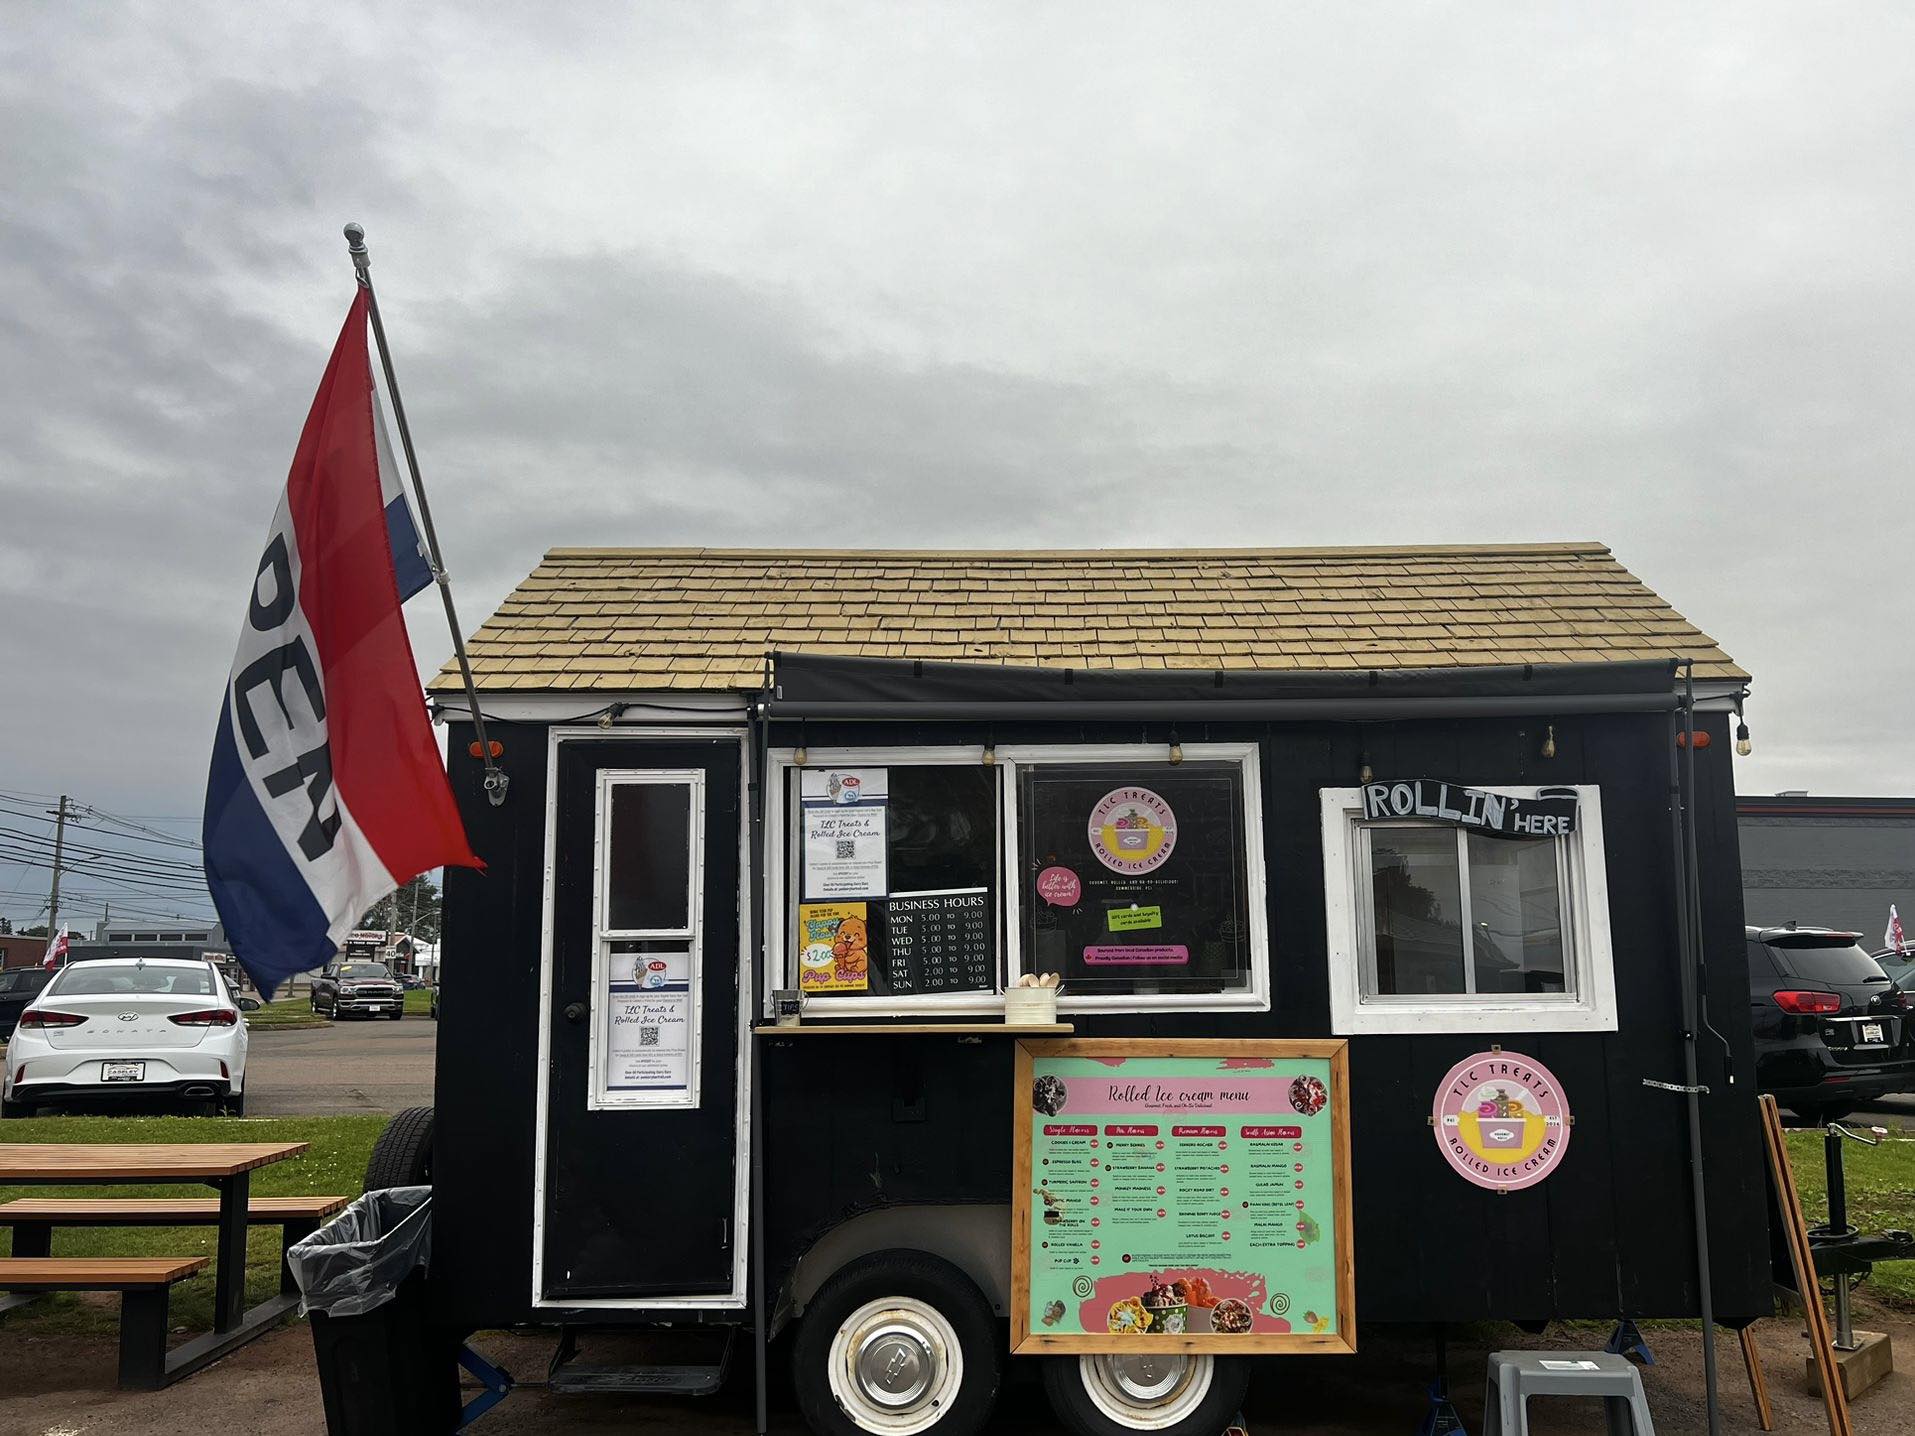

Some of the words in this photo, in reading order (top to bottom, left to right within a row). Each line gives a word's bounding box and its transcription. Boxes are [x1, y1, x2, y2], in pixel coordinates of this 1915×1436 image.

[1098, 797, 1116, 815] TLC
[1123, 791, 1166, 815] TREATS
[1366, 780, 1519, 830] ROLLIN'
[1514, 813, 1571, 835] HERE
[838, 820, 862, 828] Treats
[810, 830, 835, 840] Rolled
[836, 830, 851, 838] Ice
[853, 829, 880, 838] Cream
[1095, 842, 1123, 867] ROLLED
[1128, 862, 1143, 870] ICE
[1148, 842, 1171, 865] CREAM
[889, 899, 940, 911] BUSINESS
[944, 896, 984, 908] HOURS
[890, 915, 913, 924] MON
[891, 926, 908, 935] TUE
[891, 937, 913, 945] WED
[892, 947, 912, 956] THU
[892, 958, 906, 967] FRI
[802, 969, 831, 984] Pup
[835, 968, 866, 983] Cups
[892, 969, 908, 978] SAT
[893, 980, 912, 989] SUN
[643, 1005, 667, 1014] Treats
[614, 1016, 639, 1025] Rolled
[641, 1016, 655, 1025] Ice
[657, 1015, 685, 1024] Cream
[1453, 1071, 1478, 1097] TLC
[1489, 1064, 1549, 1098] TREATS
[1108, 1085, 1151, 1102] Rolled
[1155, 1085, 1174, 1102] Ice
[1179, 1091, 1214, 1102] cream
[1220, 1092, 1250, 1101] menu
[1449, 1137, 1489, 1173] ROLLED
[1497, 1168, 1517, 1176] ICE
[1524, 1138, 1557, 1171] CREAM
